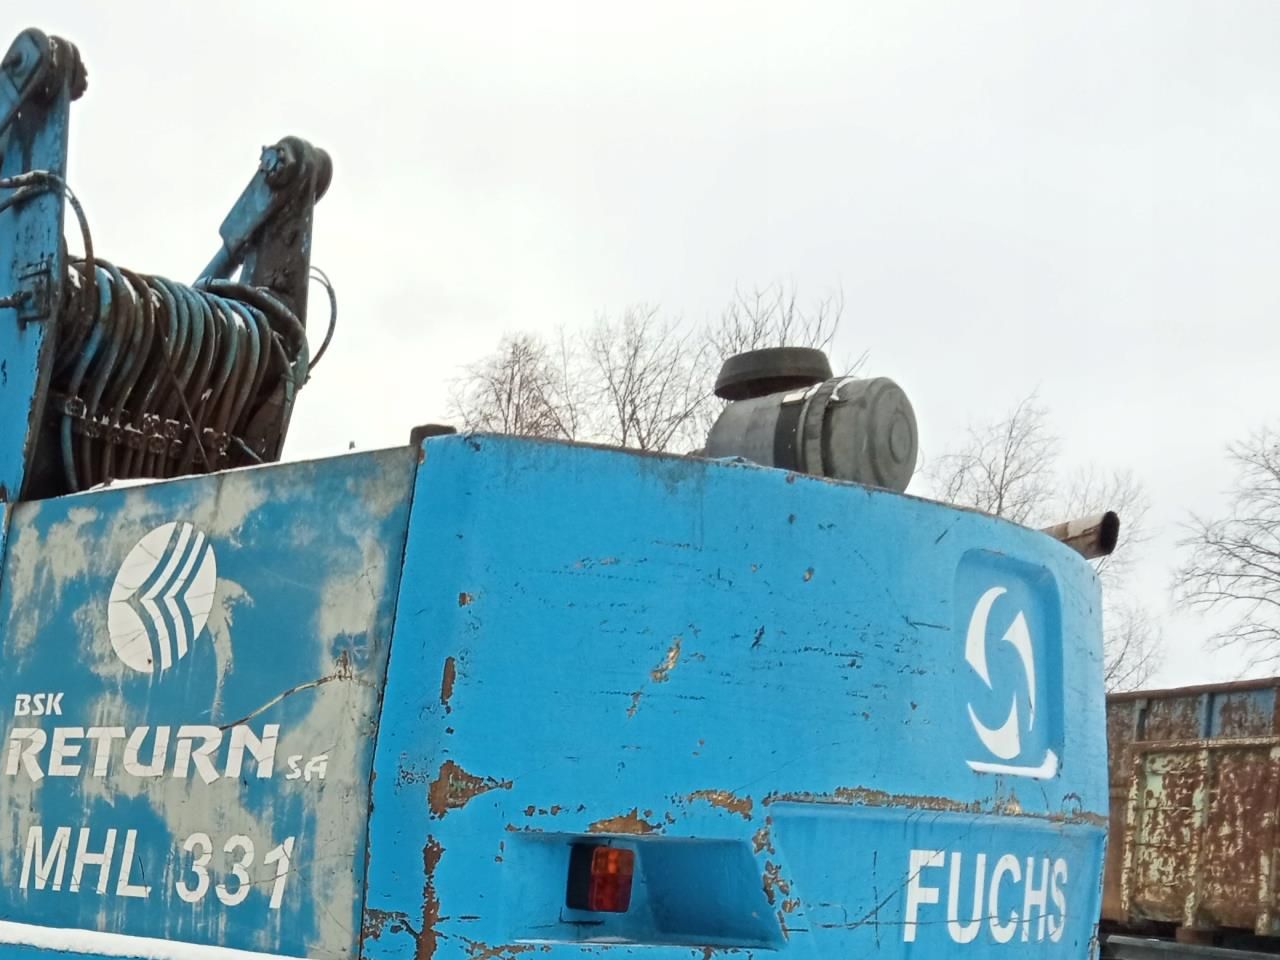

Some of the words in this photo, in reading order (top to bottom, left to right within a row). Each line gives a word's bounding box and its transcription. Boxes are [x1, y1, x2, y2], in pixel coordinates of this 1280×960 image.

[13, 691, 65, 717] BSK
[5, 723, 280, 785] RETURN
[285, 754, 329, 782] SA
[19, 825, 152, 898] MHL
[175, 832, 295, 909] 331
[903, 849, 1068, 944] FUCHS
